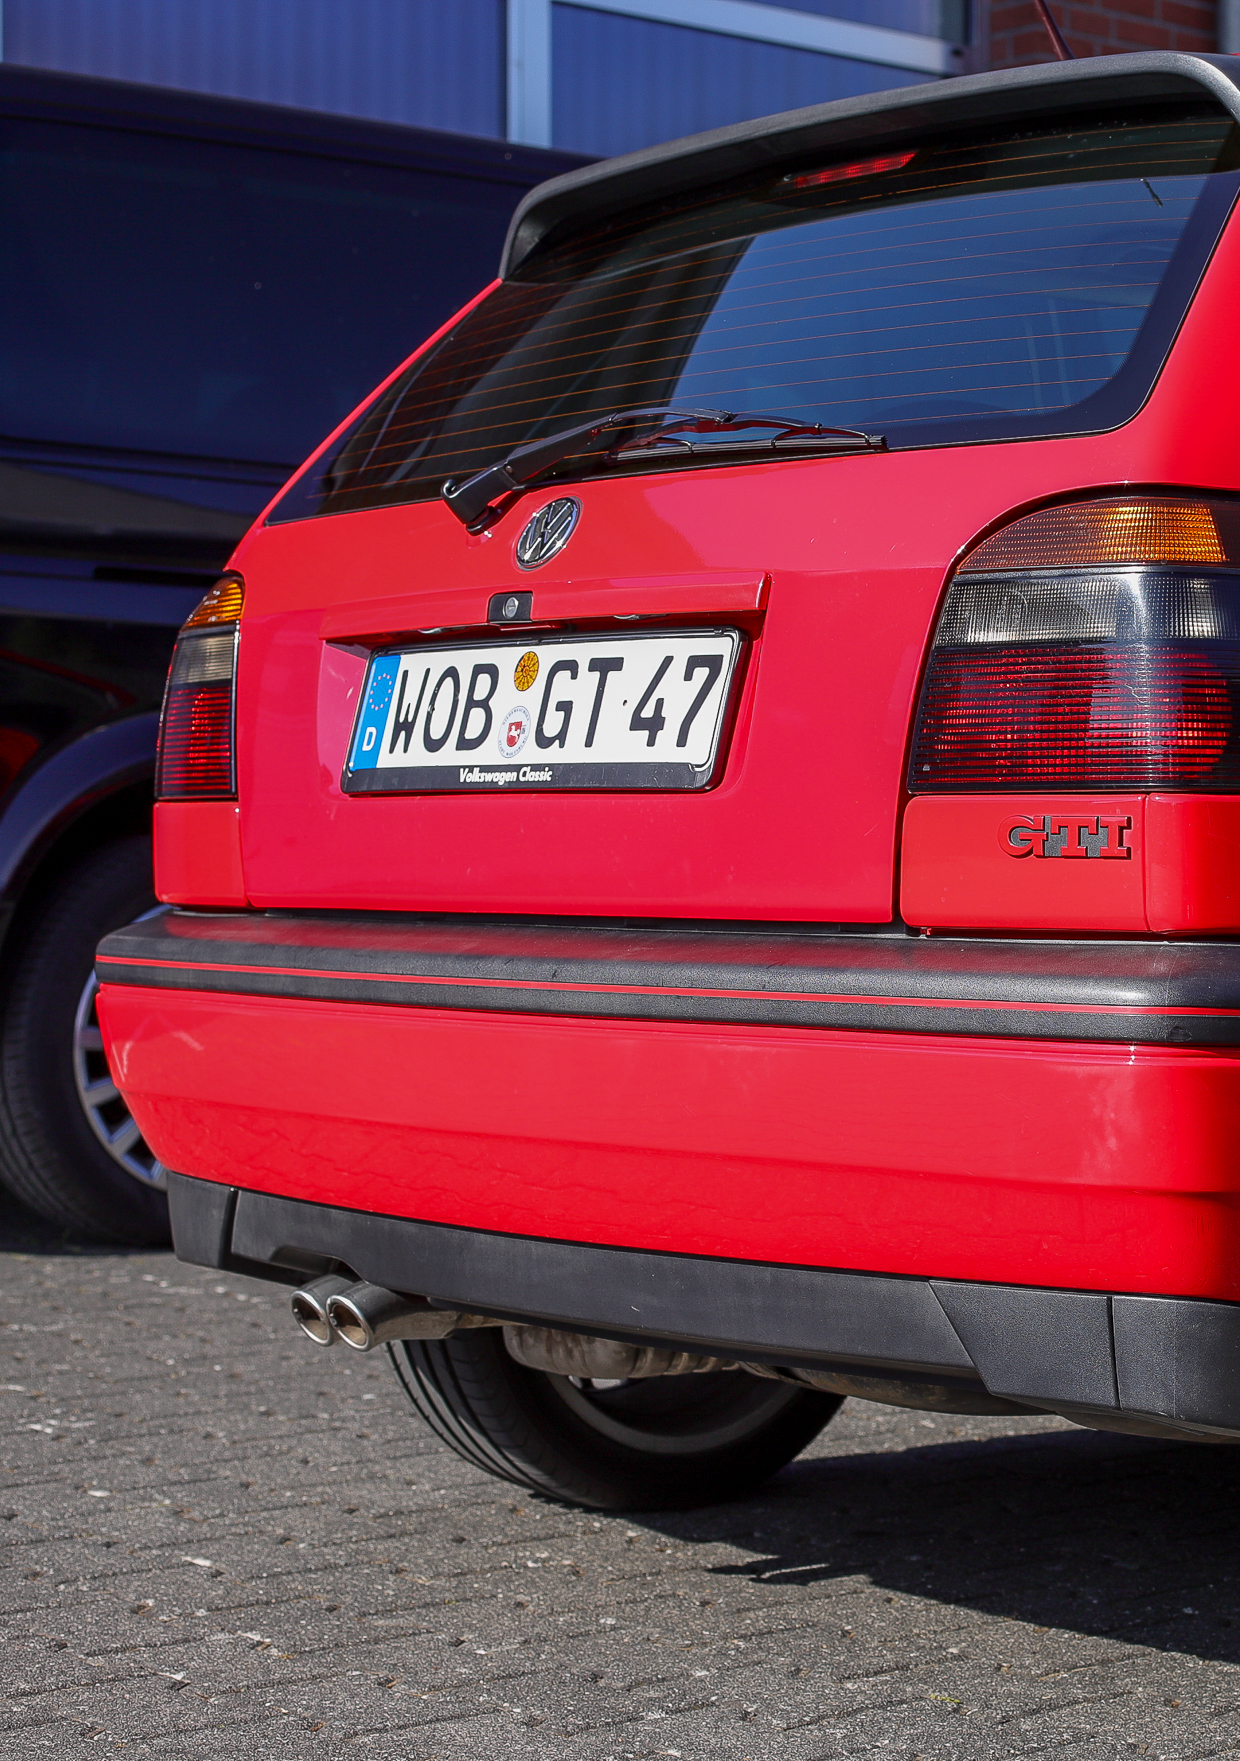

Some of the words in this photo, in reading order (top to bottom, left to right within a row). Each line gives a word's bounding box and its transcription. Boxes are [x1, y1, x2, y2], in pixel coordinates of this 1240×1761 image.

[516, 496, 582, 570] VW
[388, 663, 499, 755] WOB
[535, 656, 625, 749] GT
[629, 654, 724, 748] 47
[362, 726, 377, 751] D
[459, 767, 517, 786] Volkswagen
[519, 766, 553, 782] Classic
[997, 815, 1132, 860] GTI
